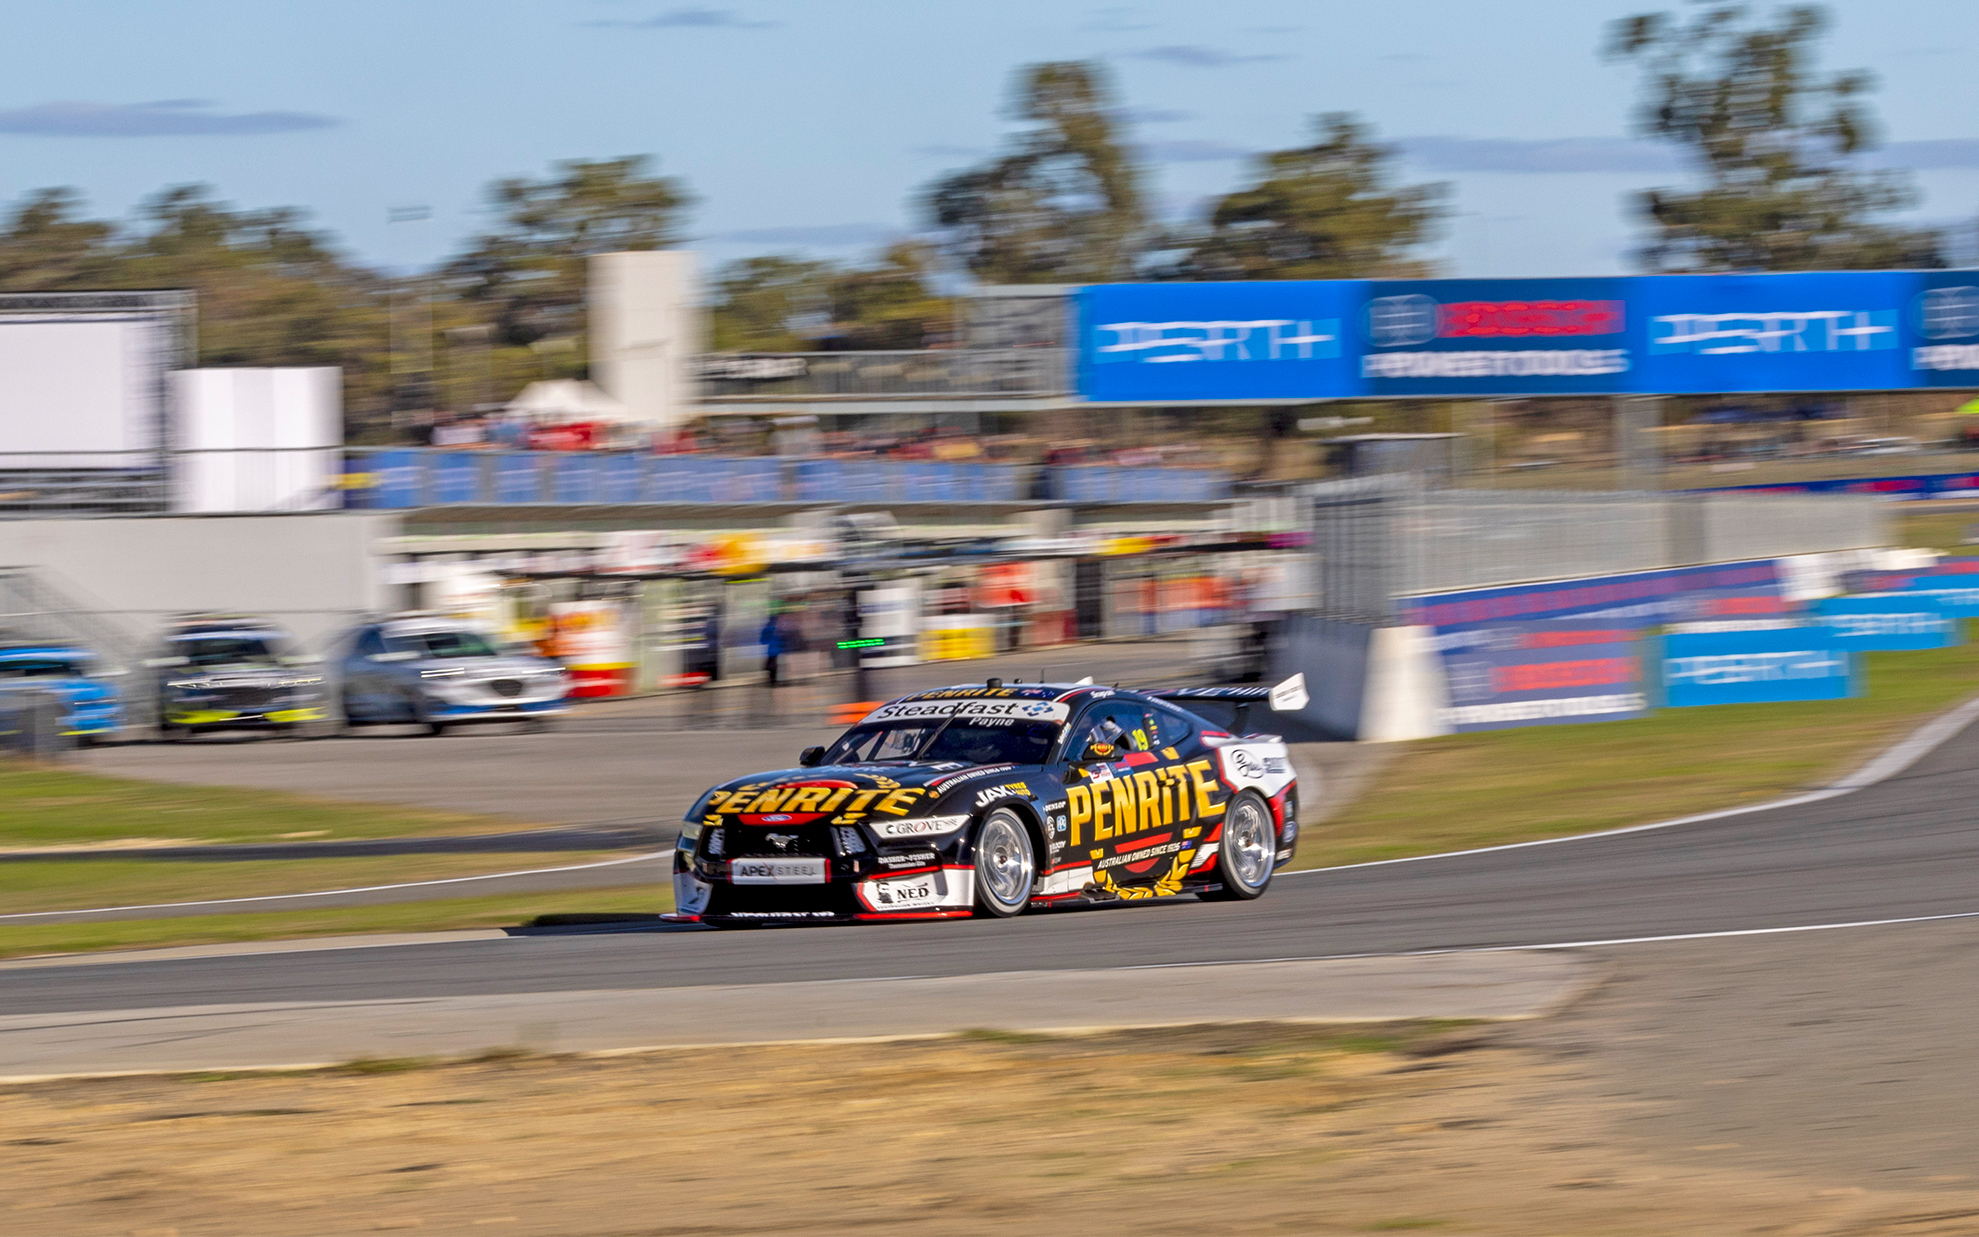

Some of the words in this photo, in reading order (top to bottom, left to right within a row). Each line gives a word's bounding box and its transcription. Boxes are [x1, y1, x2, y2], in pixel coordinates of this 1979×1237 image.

[877, 702, 1018, 719] Steadfast
[969, 716, 1014, 727] Payne
[1132, 729, 1149, 751] 19
[708, 787, 926, 817] PENRITE
[974, 784, 1015, 807] JAX
[1066, 760, 1226, 846] PENRITE
[896, 821, 943, 834] GROVE
[1097, 852, 1133, 869] AUSTRALIAN
[1131, 849, 1151, 862] OWNED
[1150, 844, 1168, 857] SINCE
[741, 862, 777, 880] APEX
[896, 887, 930, 899] NED
